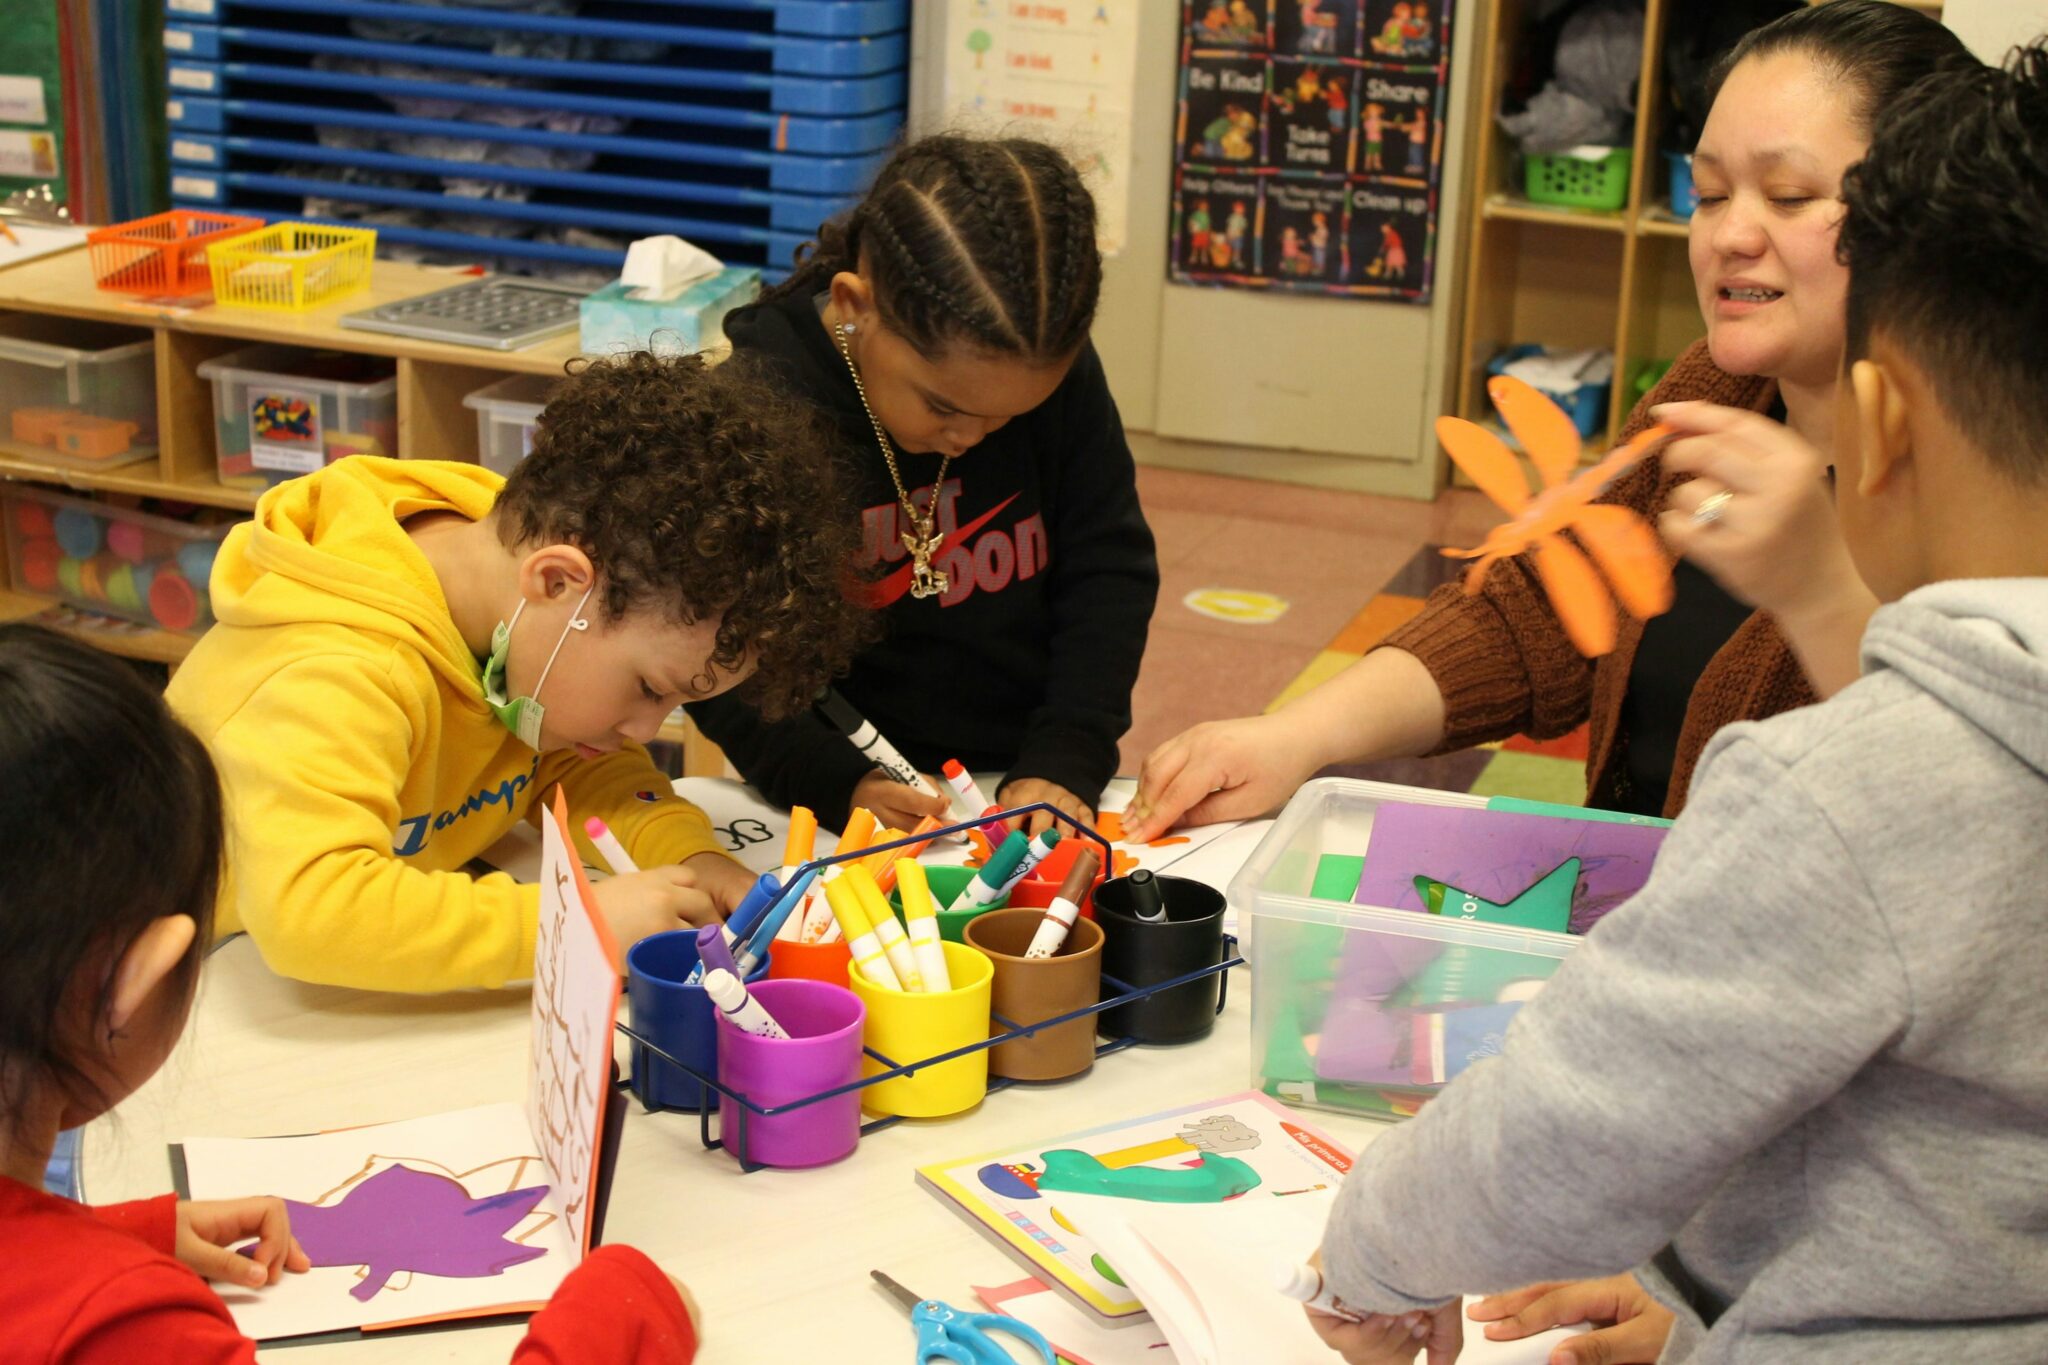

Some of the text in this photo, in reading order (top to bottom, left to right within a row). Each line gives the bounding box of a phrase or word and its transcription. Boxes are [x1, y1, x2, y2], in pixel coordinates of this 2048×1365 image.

[1190, 67, 1263, 93] Be Kind
[1366, 78, 1430, 104] Share
[1288, 124, 1330, 145] Take
[1286, 142, 1331, 164] Turns
[1354, 190, 1428, 215] Clean up
